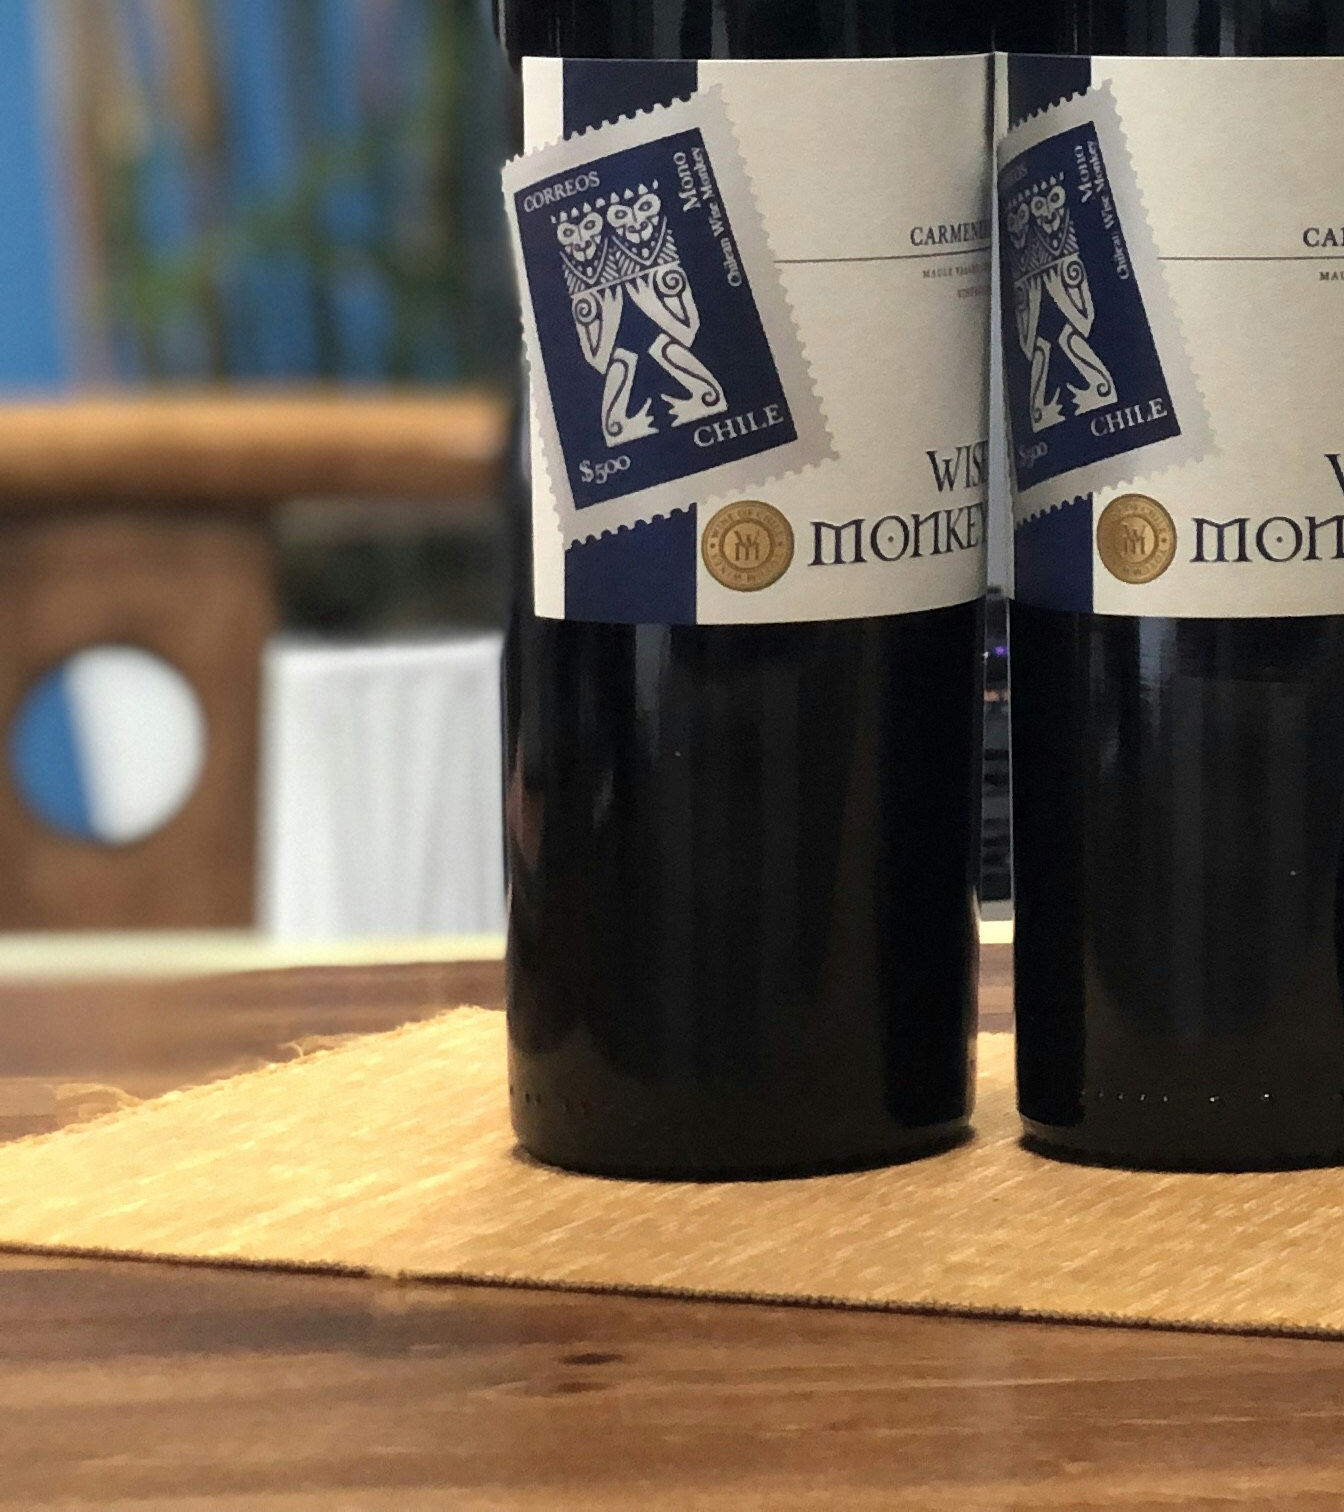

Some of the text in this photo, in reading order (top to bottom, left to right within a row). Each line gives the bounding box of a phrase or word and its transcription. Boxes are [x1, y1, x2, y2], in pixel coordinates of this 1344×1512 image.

[523, 170, 601, 213] CORREOS
[672, 151, 701, 213] Mono
[693, 402, 785, 448] CHILE
[1089, 397, 1168, 437] CHILE
[578, 454, 632, 484] $500
